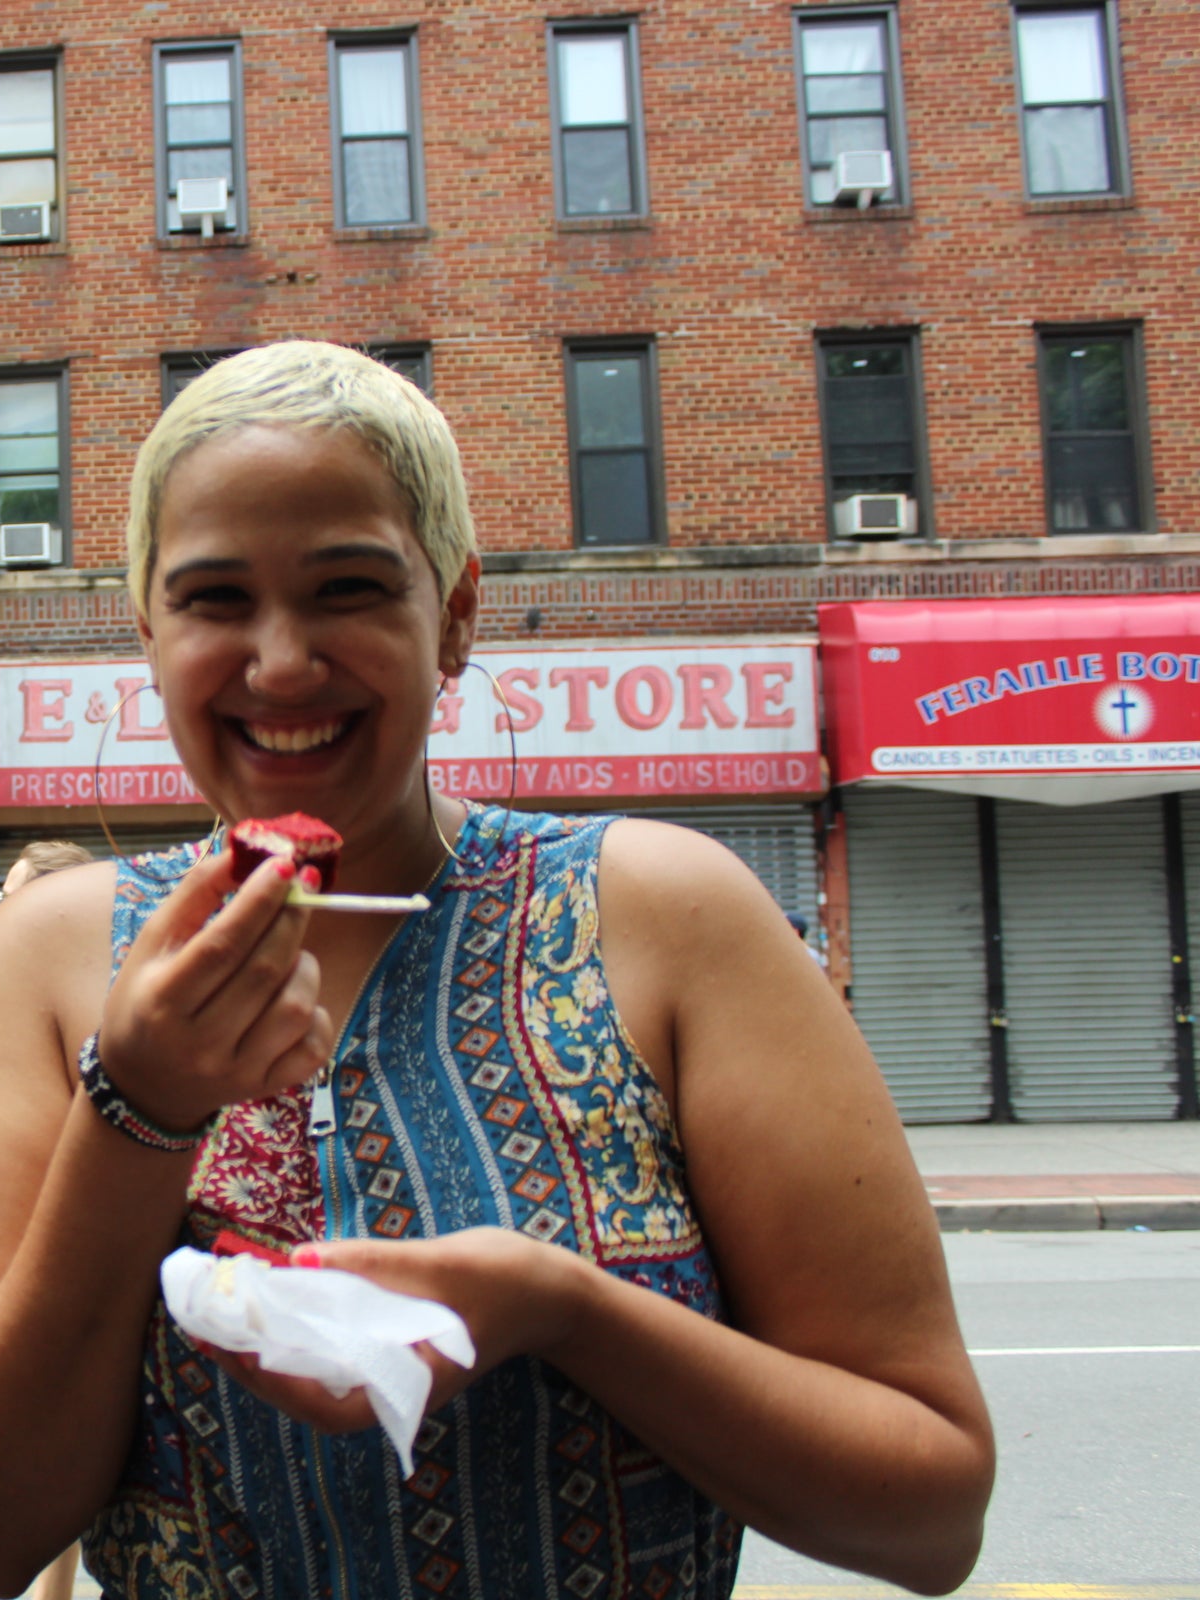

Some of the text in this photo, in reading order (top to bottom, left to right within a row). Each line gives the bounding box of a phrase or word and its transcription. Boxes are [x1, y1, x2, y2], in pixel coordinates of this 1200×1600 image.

[18, 678, 74, 743] E
[493, 662, 795, 734] STORE
[915, 653, 1105, 725] FERAILLE
[428, 759, 807, 792] BEAUTY AIDS HOUSEHOLD
[879, 751, 962, 767] CANDLES
[1093, 748, 1133, 763] OILS
